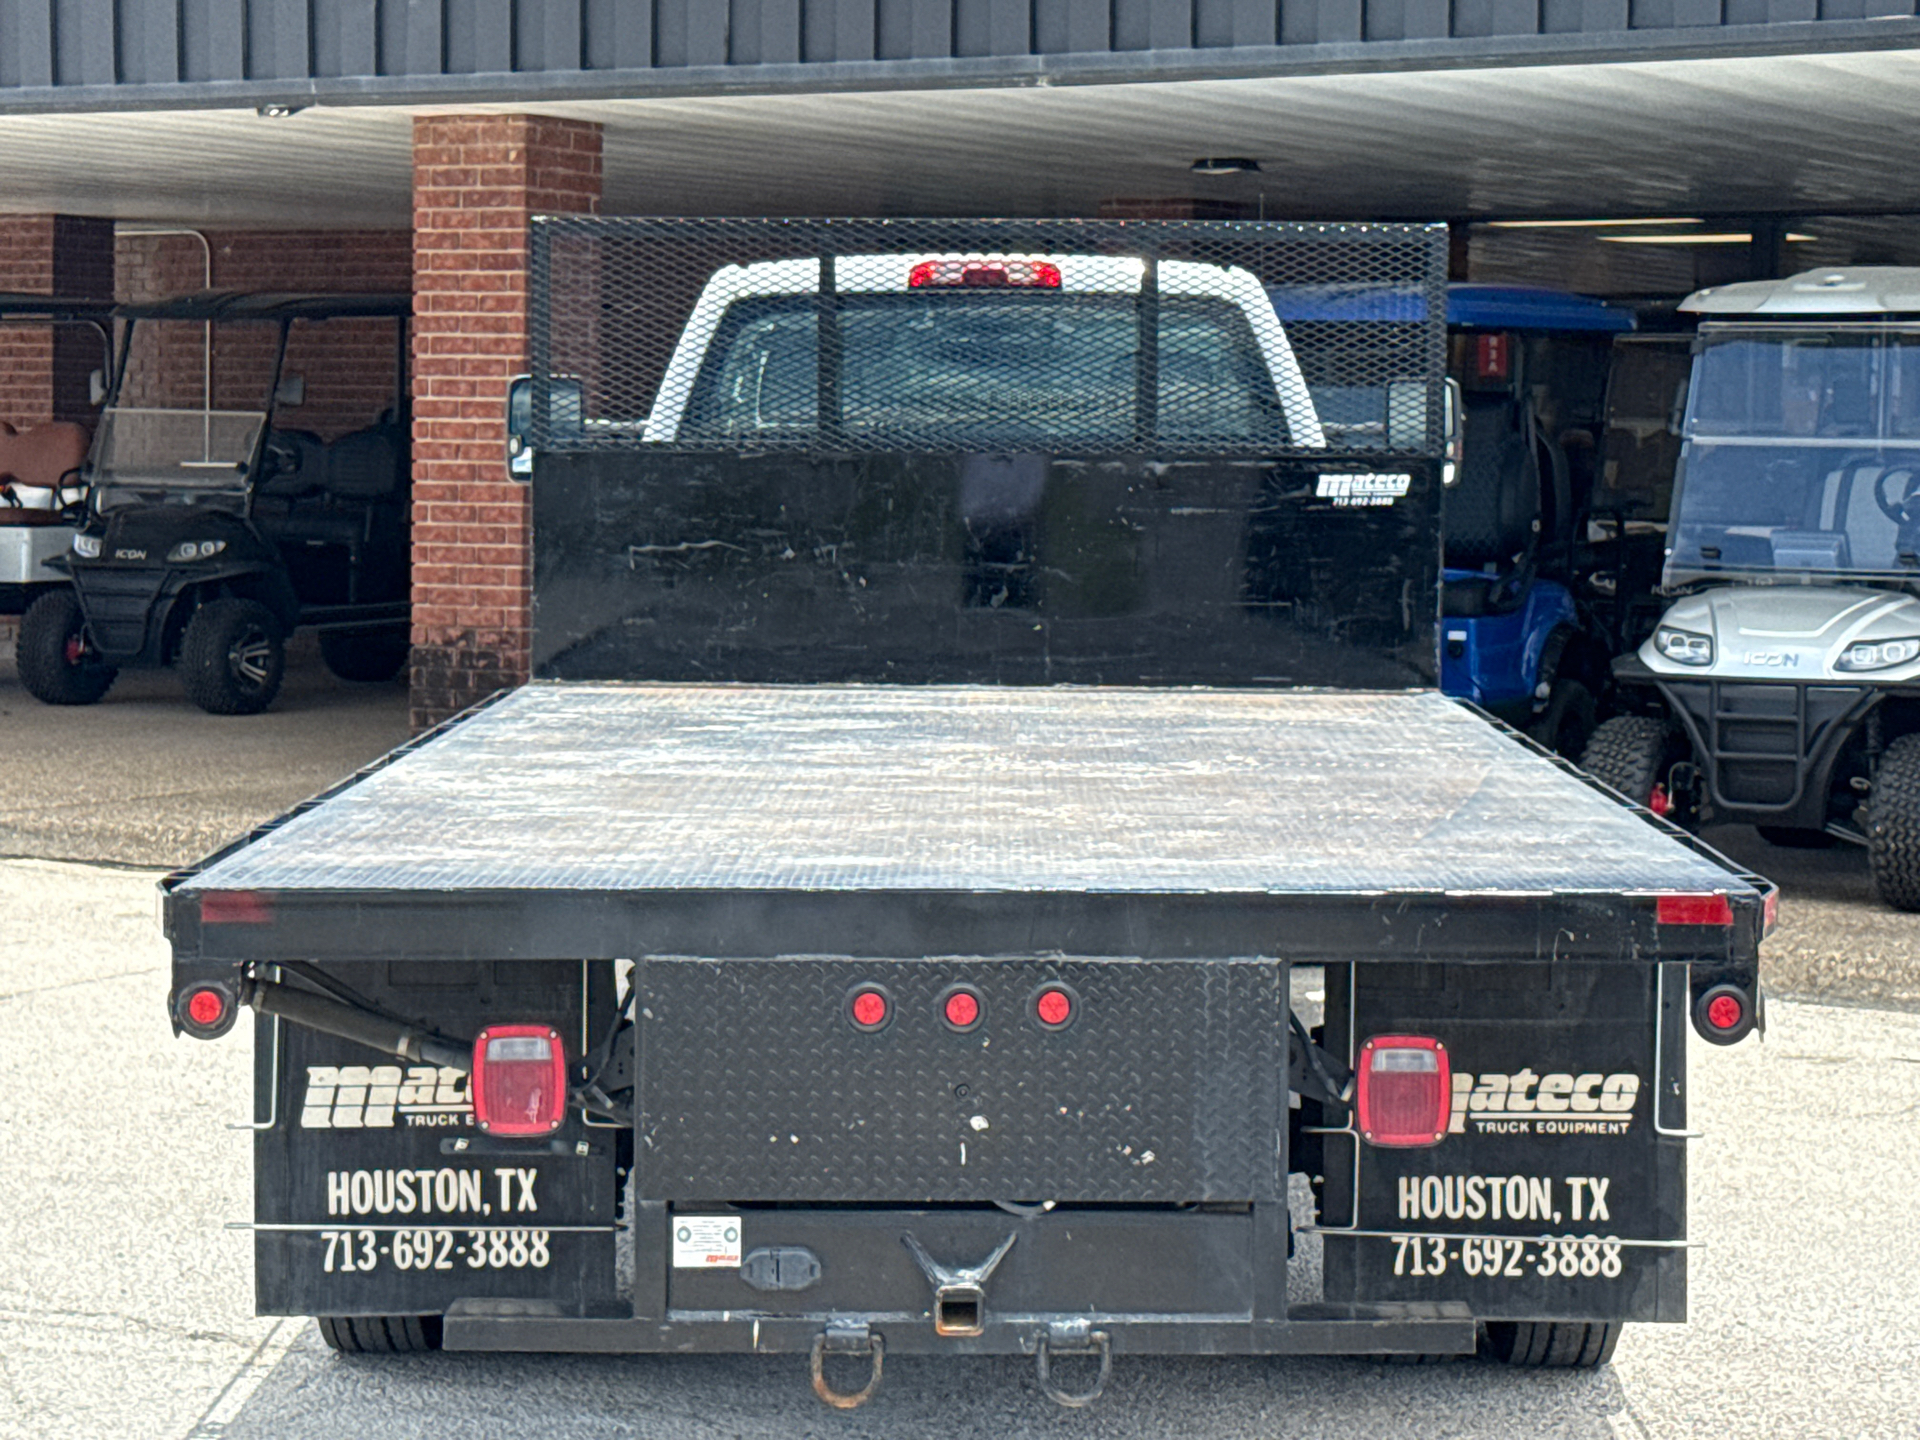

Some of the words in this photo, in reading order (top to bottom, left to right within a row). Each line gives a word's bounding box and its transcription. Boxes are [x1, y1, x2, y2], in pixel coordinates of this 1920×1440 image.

[1316, 473, 1411, 497] mateco
[115, 549, 147, 560] ICON
[1743, 651, 1799, 667] ICON
[405, 1114, 459, 1127] TRUCK
[1475, 1121, 1530, 1134] TRUCK
[1536, 1121, 1630, 1135] EQUIPMENT
[328, 1168, 491, 1216] HOUSTON,
[494, 1168, 538, 1212] TX
[1398, 1175, 1562, 1224] HOUSTON,
[1565, 1177, 1610, 1221] TX
[320, 1229, 550, 1273] 713-692-3888
[1390, 1234, 1622, 1278] 713-692-3888
